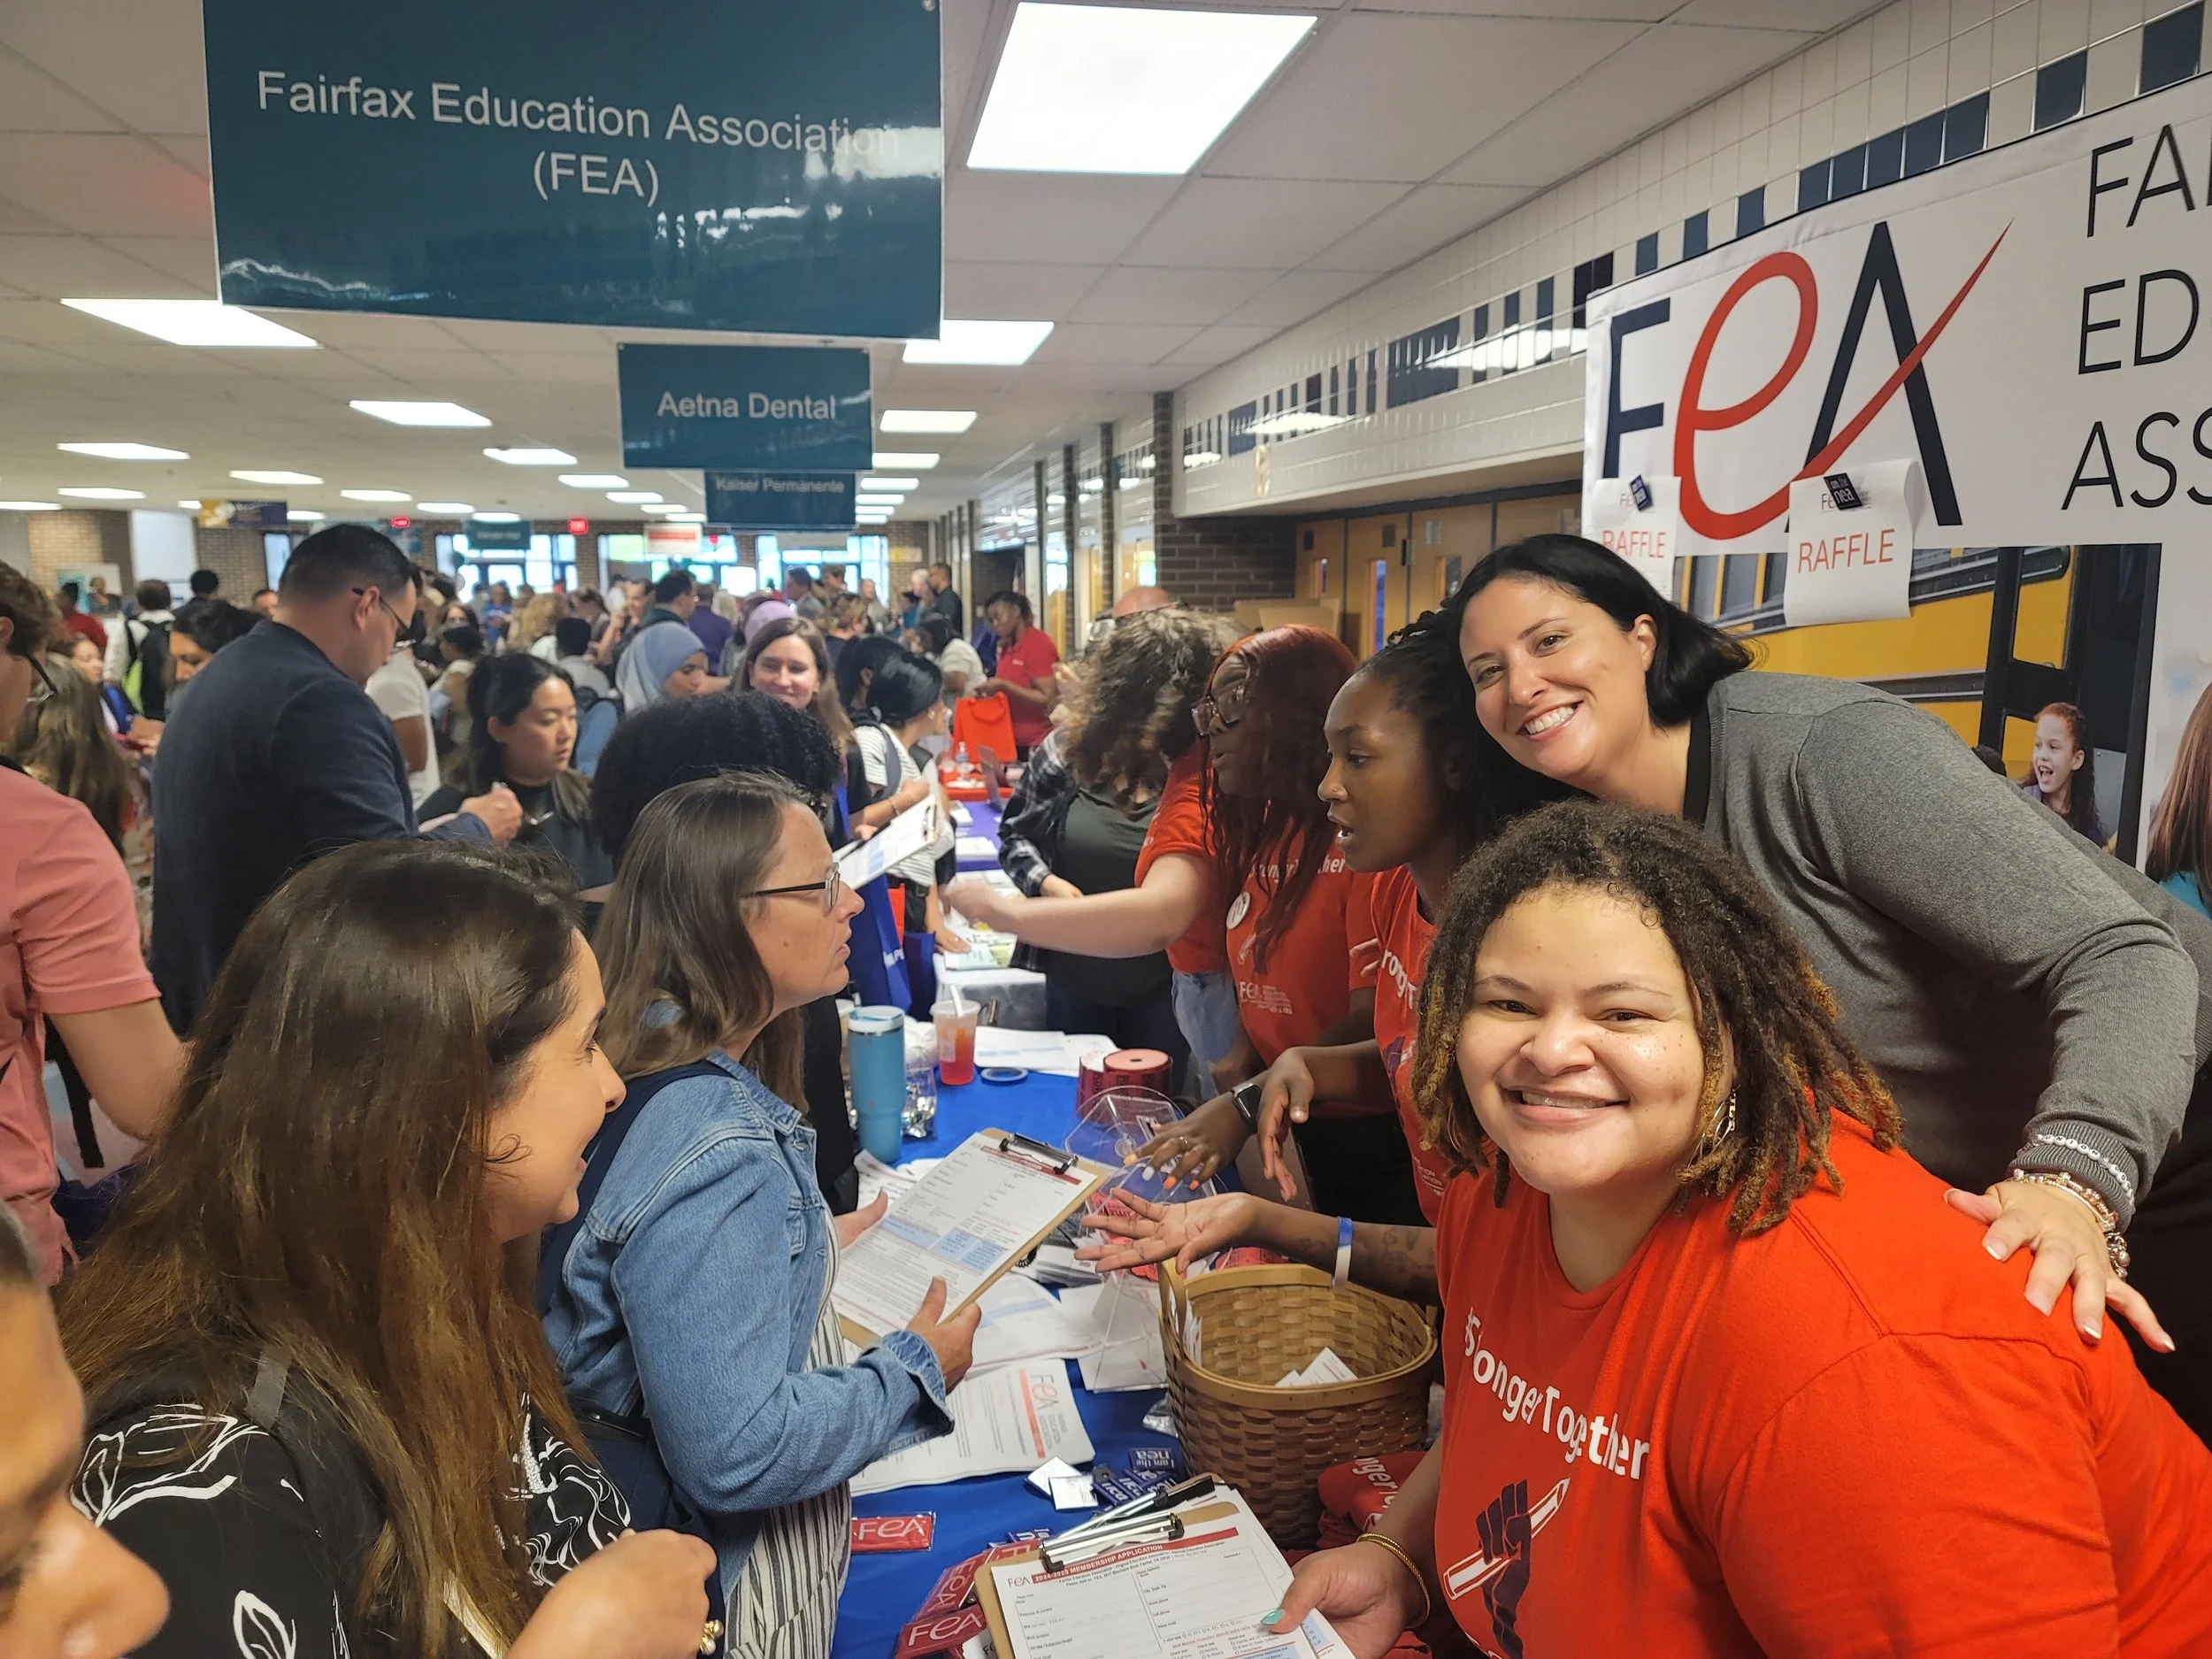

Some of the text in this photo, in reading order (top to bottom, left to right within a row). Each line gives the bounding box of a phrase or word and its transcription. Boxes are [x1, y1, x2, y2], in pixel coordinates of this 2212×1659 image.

[258, 70, 899, 157] Fairfax Education Association
[534, 150, 659, 208] (FEA)
[657, 390, 836, 419] Aetna Dental
[715, 476, 845, 494] Kaiser Permanente
[1601, 529, 1667, 559] RAFFLE
[1798, 528, 1895, 574] RAFFLE
[1069, 1555, 1117, 1575] MEMBERSHIP
[1117, 1544, 1164, 1561] APPLICATION
